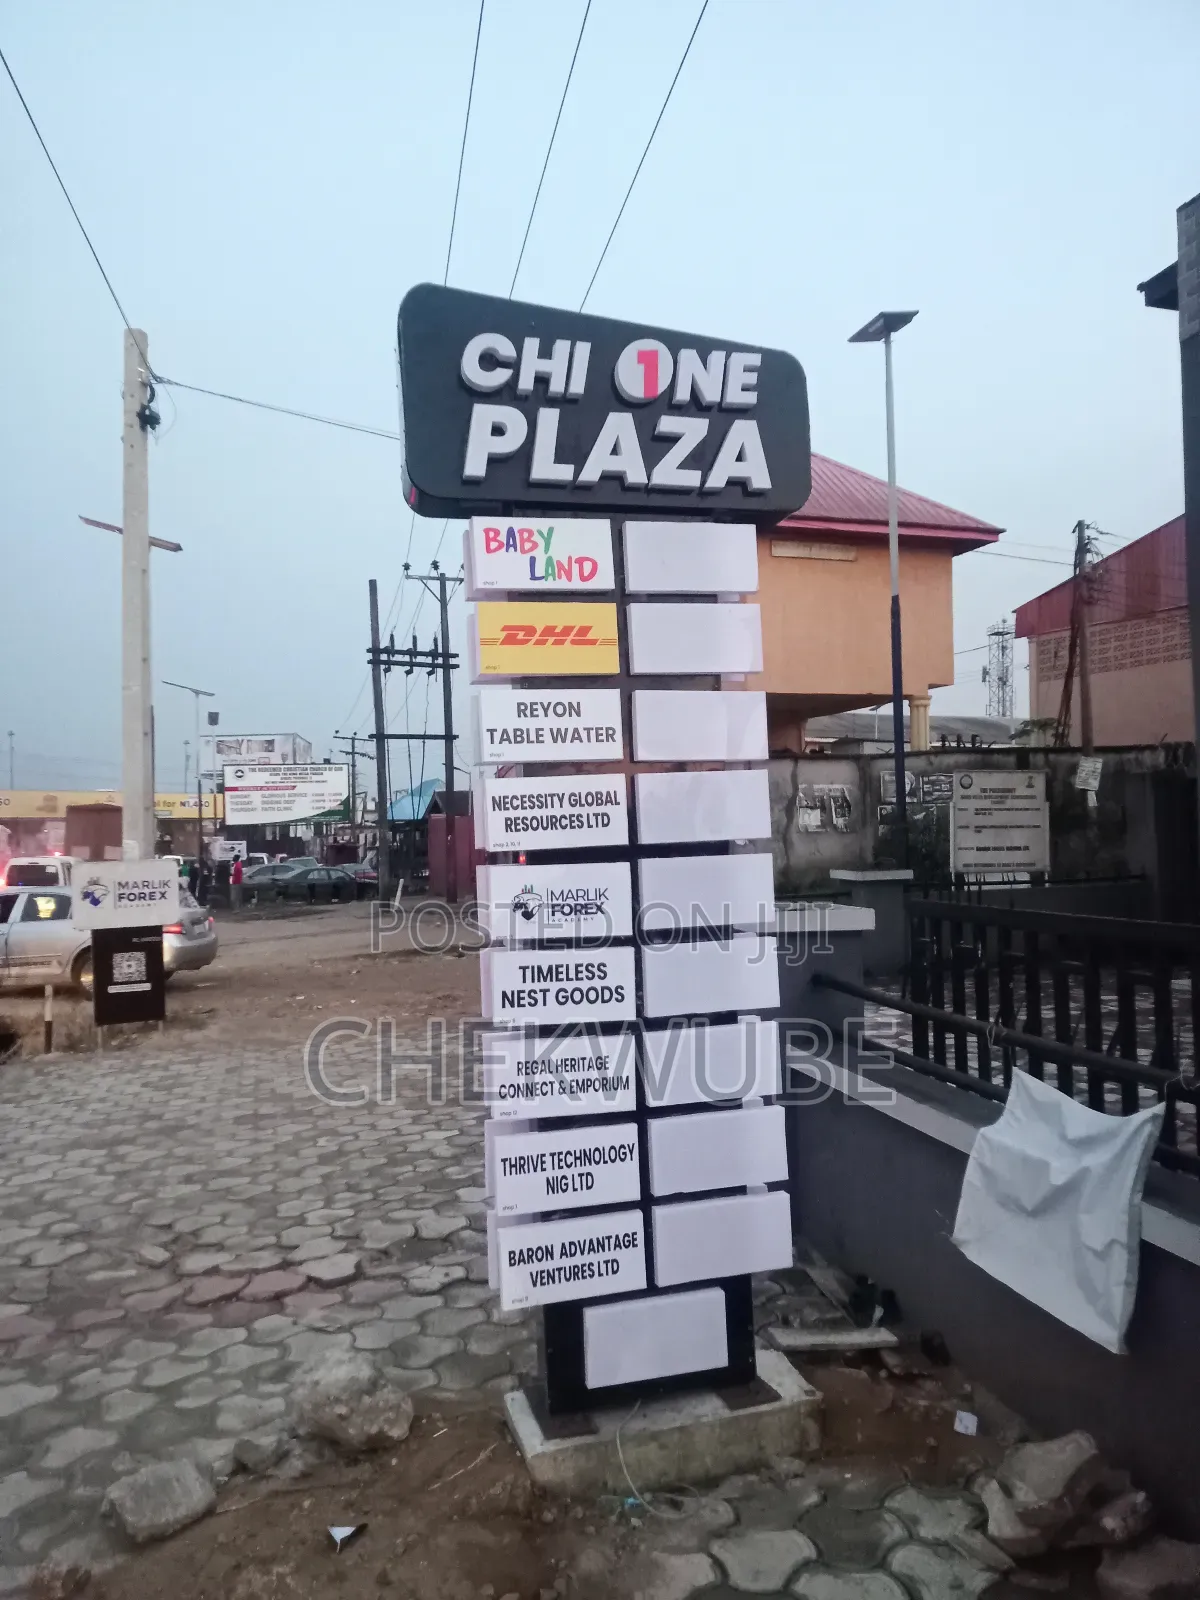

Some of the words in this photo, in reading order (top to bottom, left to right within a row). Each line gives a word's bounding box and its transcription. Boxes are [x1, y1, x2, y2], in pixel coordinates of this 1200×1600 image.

[461, 333, 592, 399] CHI
[462, 404, 772, 492] PLAZA
[483, 526, 554, 554] BABY
[529, 556, 598, 582] LAND
[500, 625, 600, 646] DHL
[516, 702, 581, 718] REYON
[486, 728, 544, 744] TABLE
[550, 727, 616, 744] WATER
[492, 793, 565, 811] NECESSITY
[568, 790, 620, 807] GLOBAL
[505, 814, 584, 832] RESOURCES
[587, 812, 610, 828] LTD
[118, 880, 171, 890] MARLIK
[550, 888, 609, 902] MARLIK
[118, 891, 168, 902] FOREX
[551, 902, 605, 916] FOREX
[519, 962, 608, 983] TIMELESS
[502, 989, 550, 1008] NEST
[555, 985, 625, 1005] GOODS
[517, 1060, 552, 1076] REGAL
[555, 1055, 609, 1073] HERITAGE
[499, 1080, 555, 1099] CONNECT
[558, 1080, 567, 1095] &
[570, 1076, 630, 1094] EMPORIUM
[501, 1154, 547, 1176] THRIVE
[549, 1143, 635, 1170] TECHNOLOGY
[546, 1175, 568, 1195] NIG
[572, 1172, 594, 1192] LTD
[508, 1244, 554, 1267] BARON
[559, 1232, 638, 1259] ADVANTAGE
[530, 1262, 595, 1288] VENTURES
[598, 1259, 620, 1276] LTD
